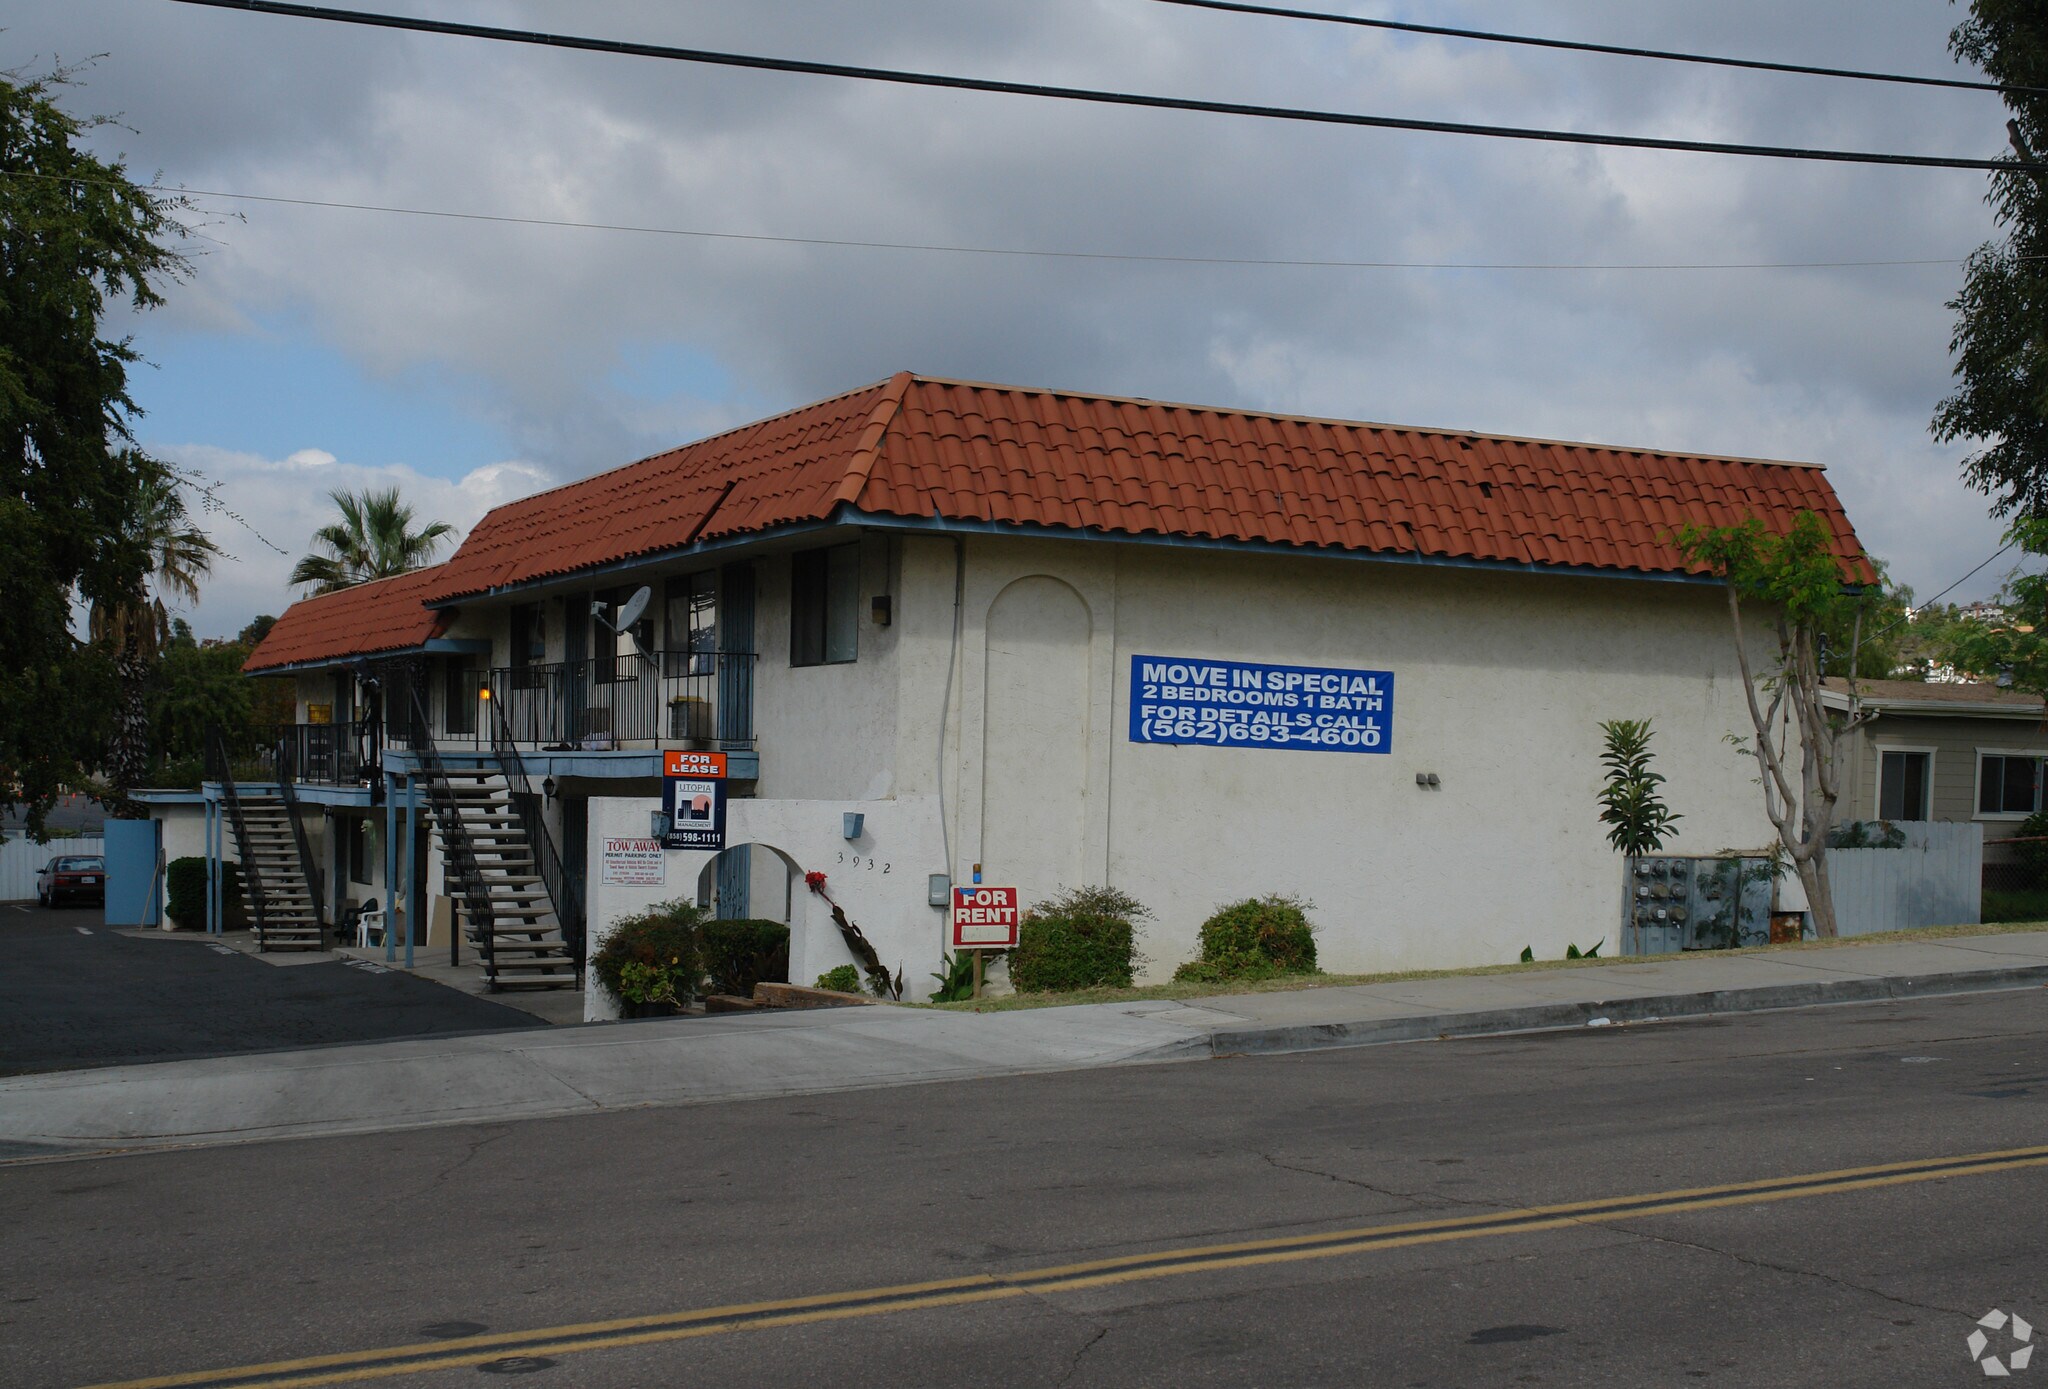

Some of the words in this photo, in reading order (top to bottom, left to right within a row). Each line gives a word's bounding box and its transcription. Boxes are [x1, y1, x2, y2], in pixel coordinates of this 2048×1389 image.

[1142, 663, 1228, 687] MOVE
[1233, 669, 1262, 689] IN
[1266, 672, 1384, 696] SPECIAL
[1142, 684, 1158, 699] 2
[1162, 685, 1299, 707] BEDROOMS
[1302, 695, 1314, 708] 1
[1320, 697, 1382, 711] BATH
[1141, 705, 1196, 721] FOR
[1201, 707, 1312, 727] DETAILS
[1316, 714, 1381, 730] CALL
[1141, 718, 1381, 747] (562)693-4600
[680, 754, 710, 764] FOR
[671, 764, 719, 774] LEASE
[680, 784, 711, 792] UTOPIA
[607, 841, 631, 851] TOW
[633, 841, 661, 852] AWAY
[837, 851, 891, 874] 3932
[962, 890, 1008, 906] FOR
[955, 907, 1016, 924] RENT
